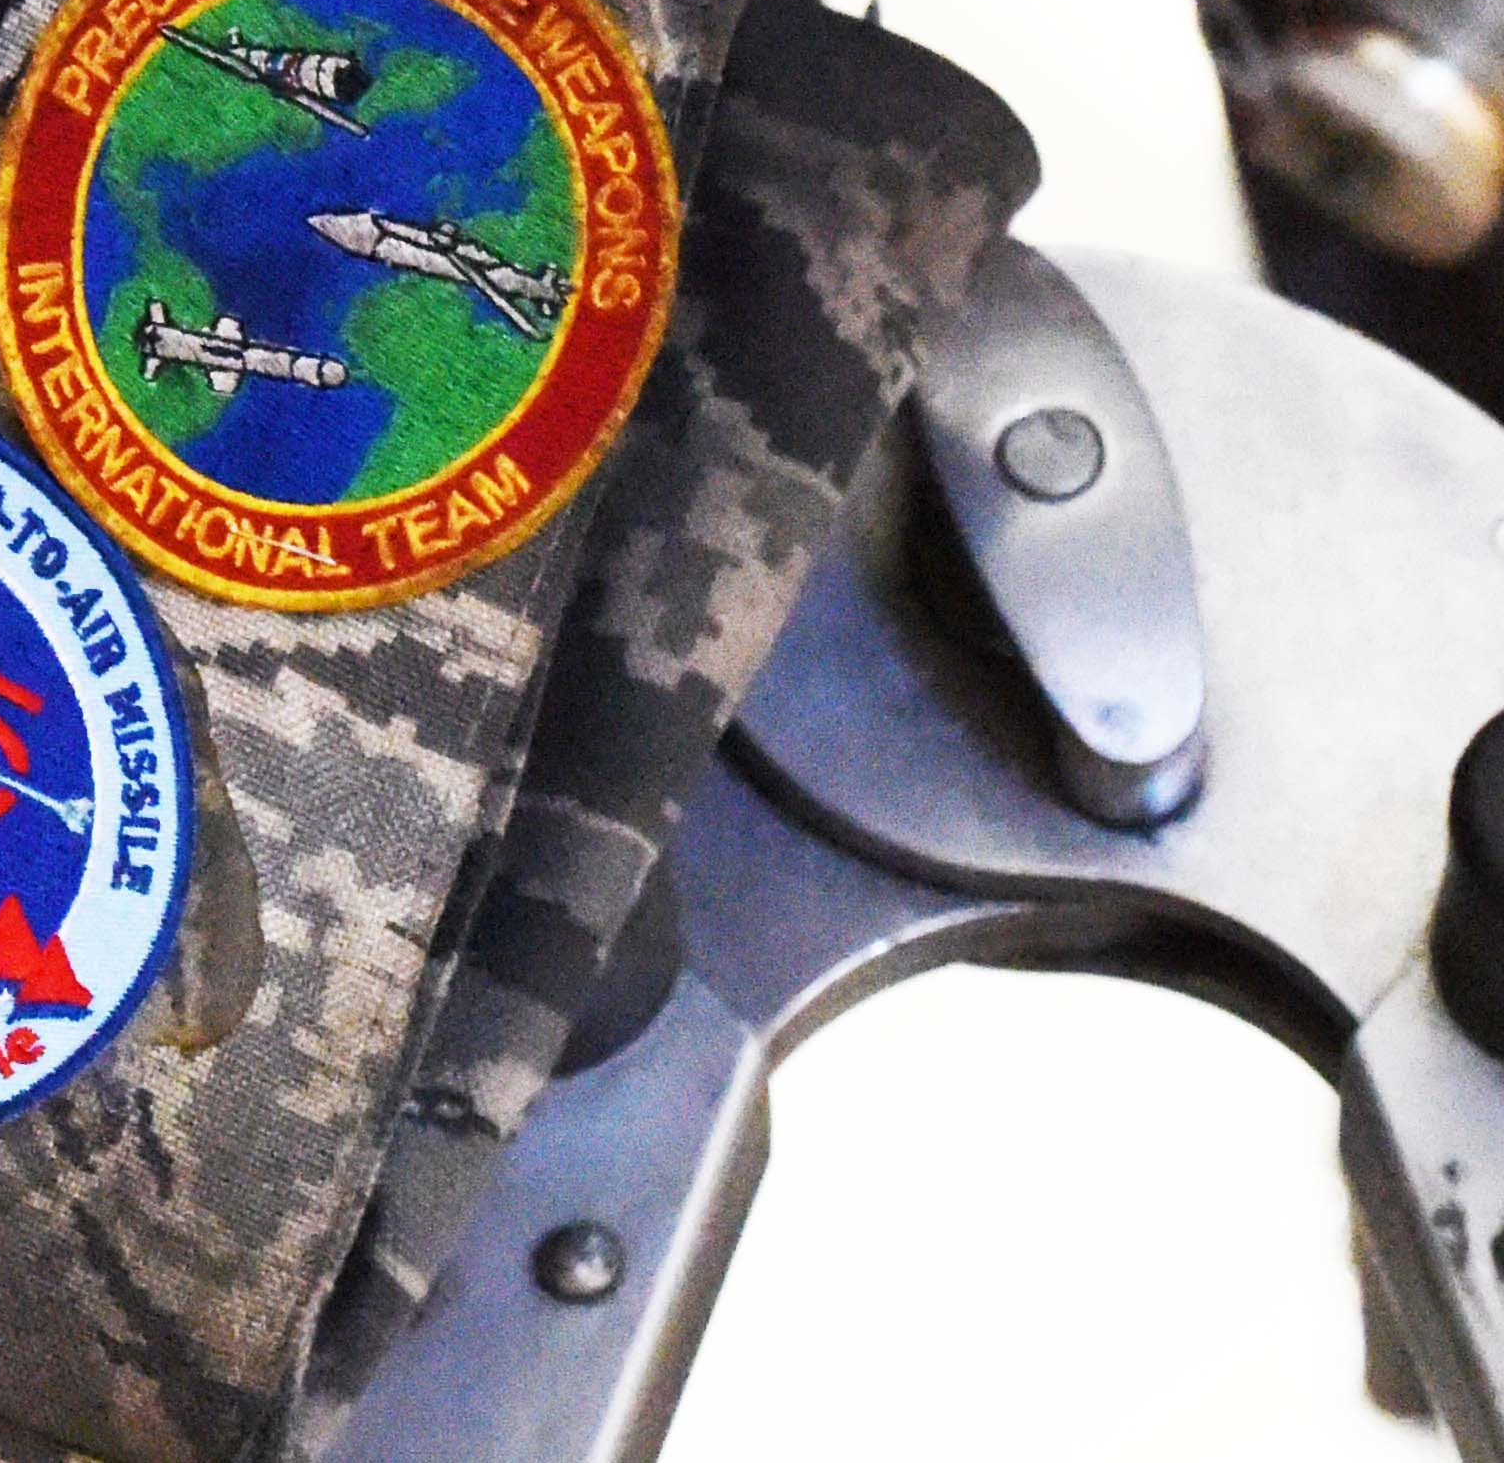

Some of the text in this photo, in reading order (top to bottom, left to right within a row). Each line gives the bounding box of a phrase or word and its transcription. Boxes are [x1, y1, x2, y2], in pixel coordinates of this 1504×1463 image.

[529, 5, 645, 310] WEAPONS
[18, 260, 530, 578] INTERNATIONAL TEAM
[103, 681, 162, 896] MISSILE
